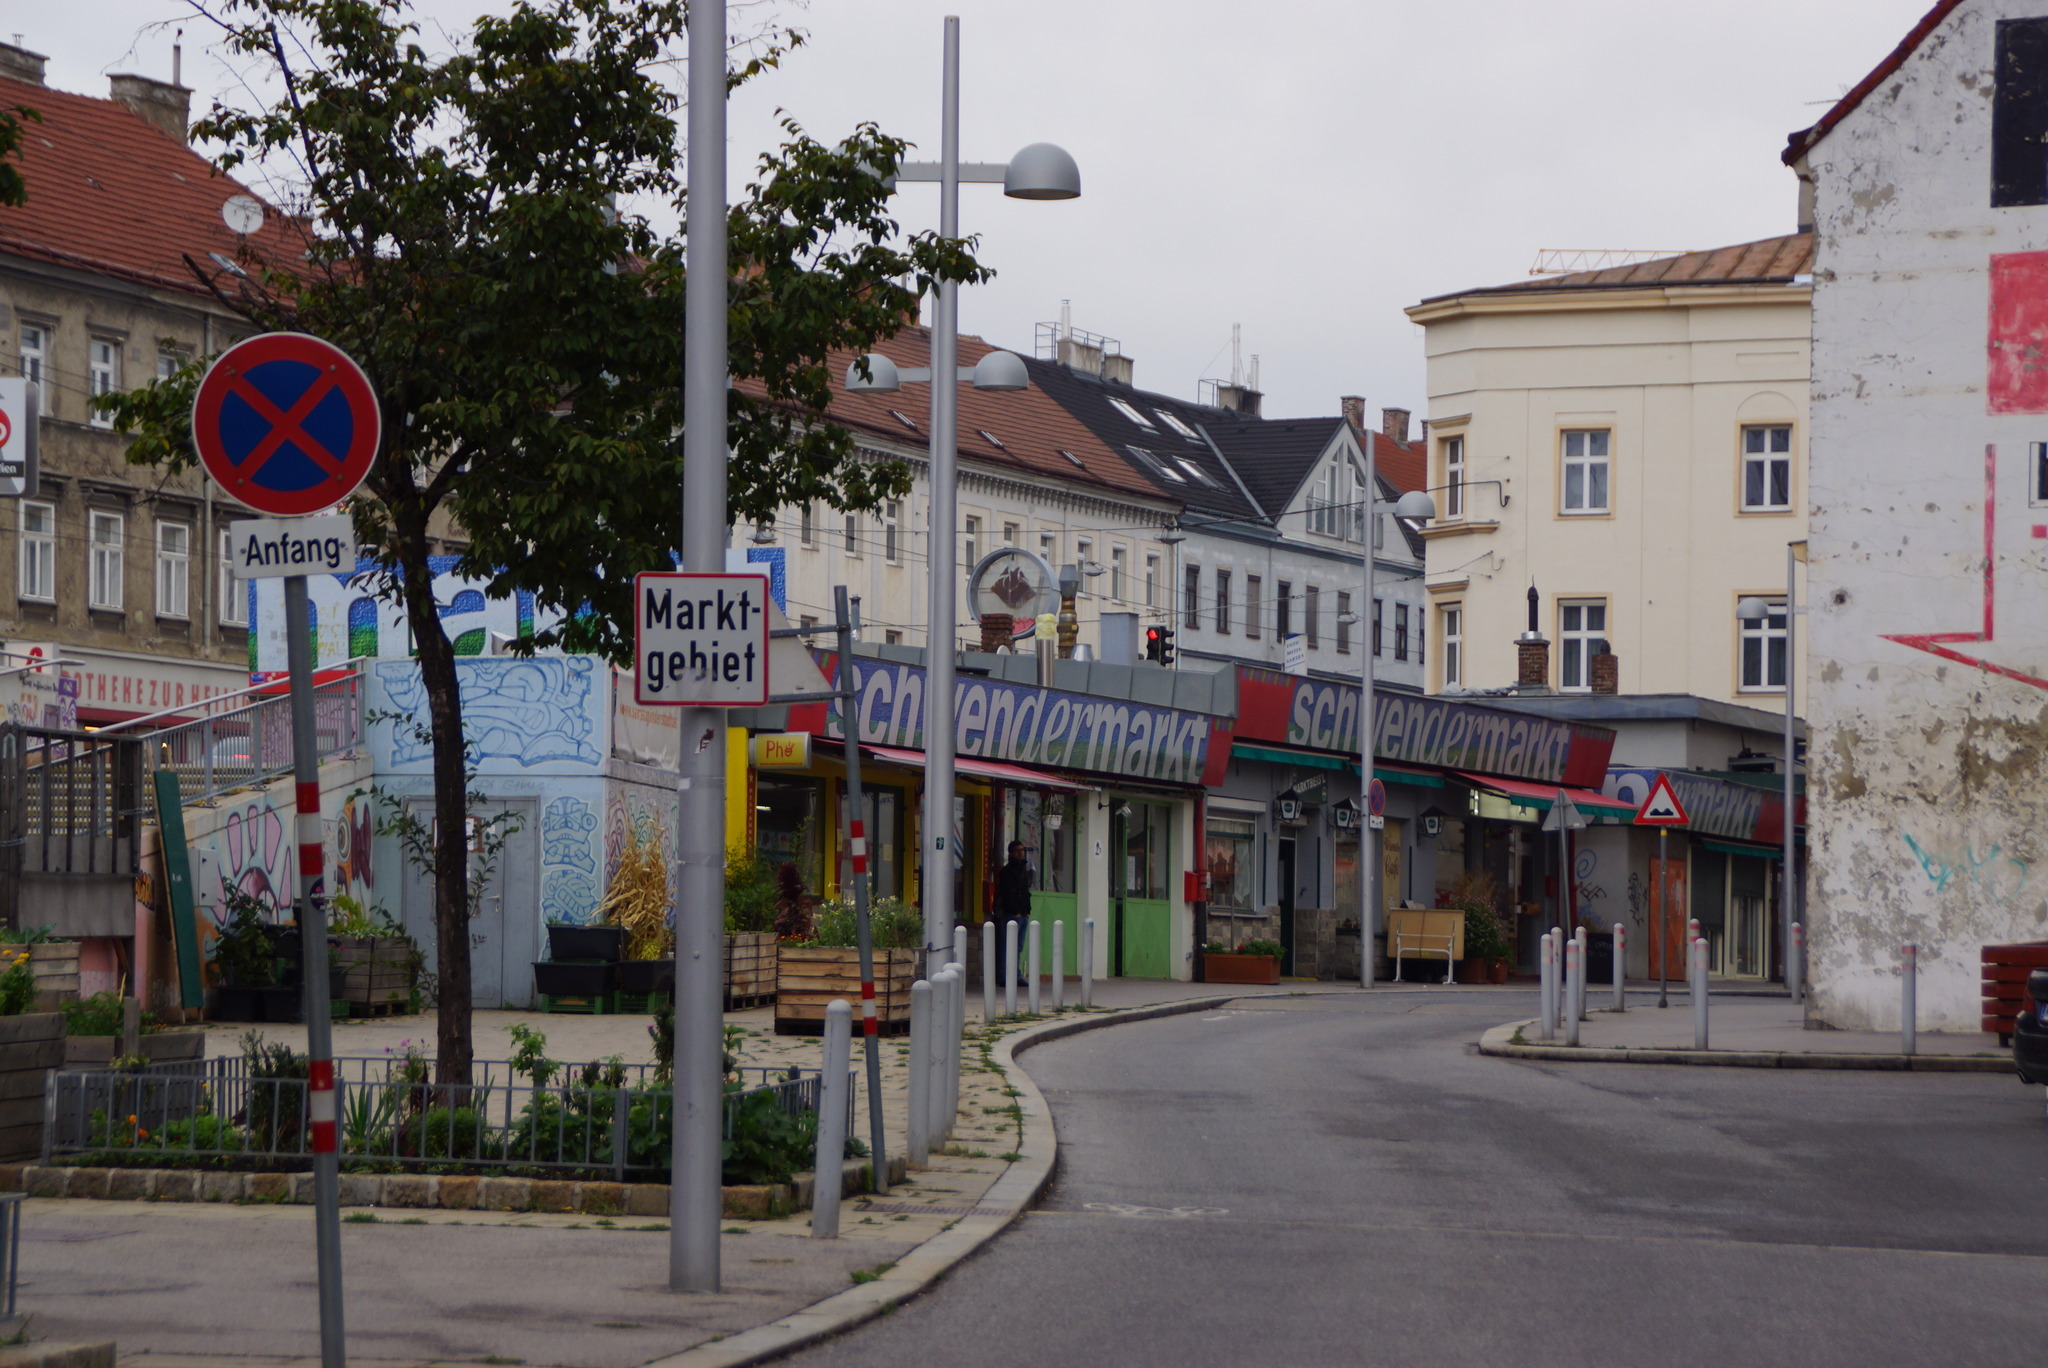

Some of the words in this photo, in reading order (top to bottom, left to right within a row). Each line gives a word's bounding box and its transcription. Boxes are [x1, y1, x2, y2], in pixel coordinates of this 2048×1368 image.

[245, 531, 341, 569] Anfang
[646, 587, 761, 631] Markt-
[61, 670, 143, 705] OTHEKE
[149, 680, 184, 708] ZUR
[647, 639, 756, 693] gebiet
[828, 664, 1208, 783] schendermarkt
[1289, 683, 1570, 783] schwendermarkt
